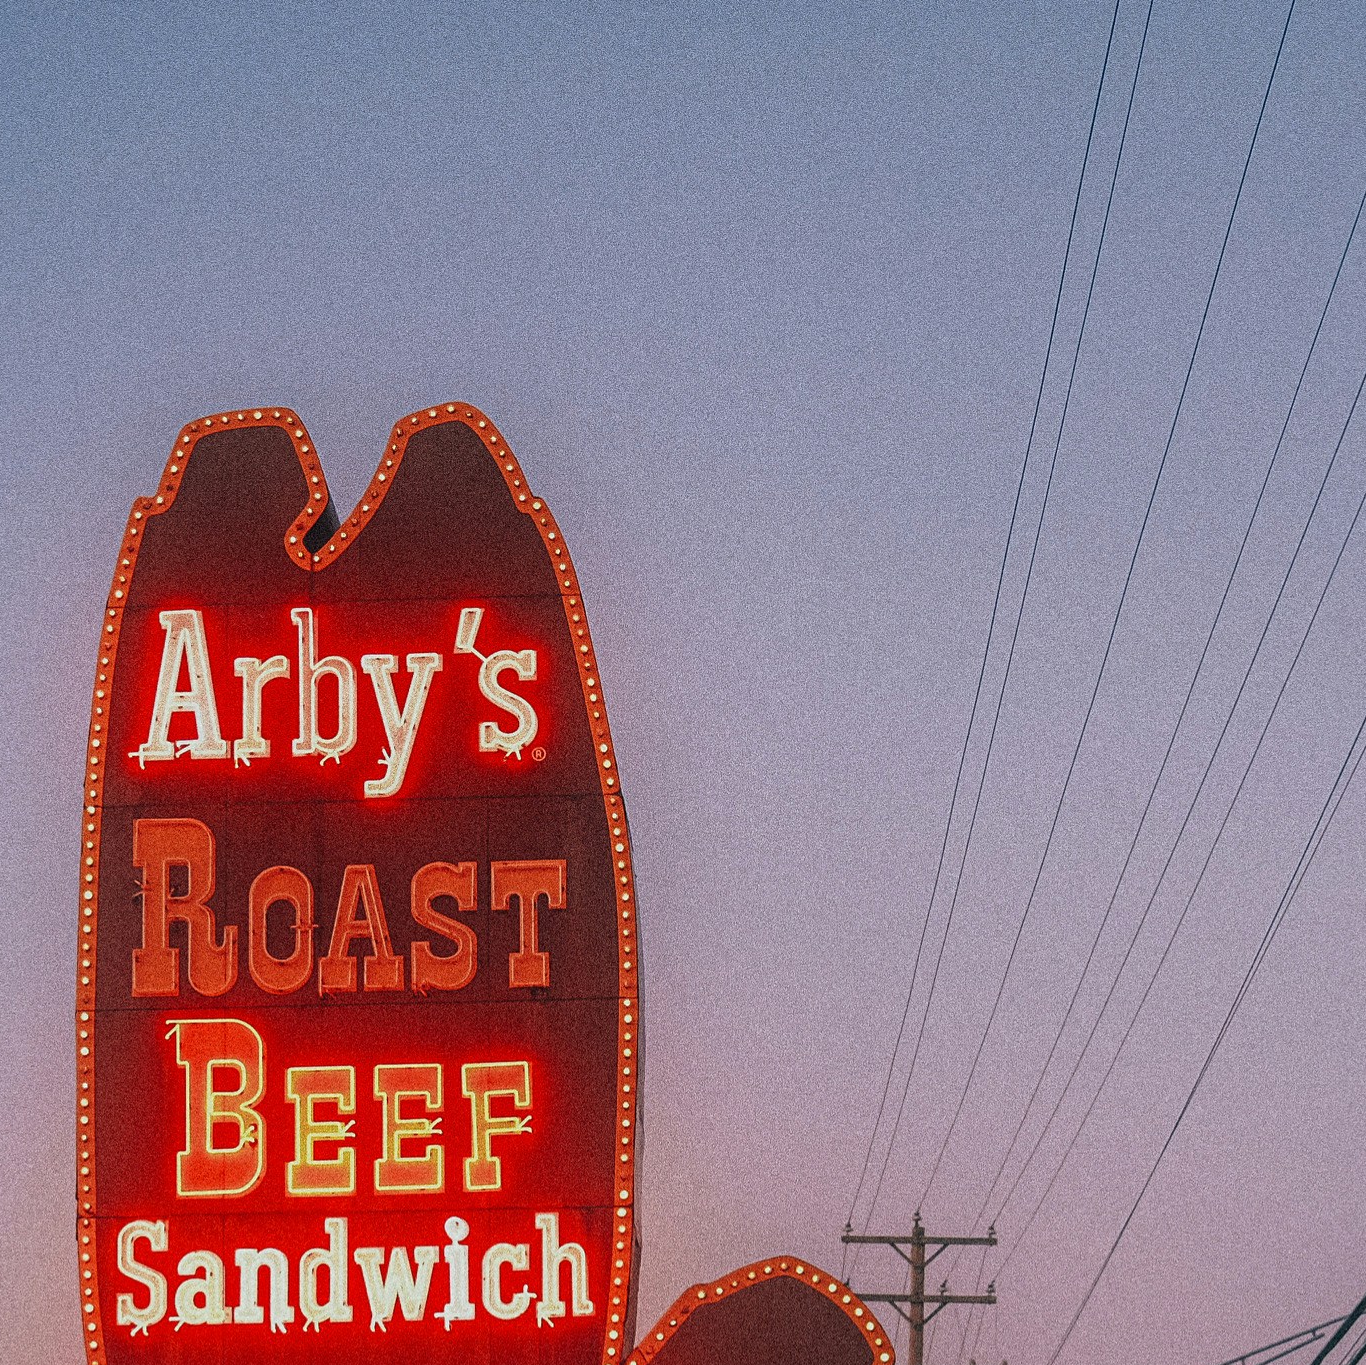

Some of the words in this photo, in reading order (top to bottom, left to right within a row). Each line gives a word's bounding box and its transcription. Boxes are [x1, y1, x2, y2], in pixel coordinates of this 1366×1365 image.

[137, 606, 537, 798] Arby's
[131, 817, 567, 998] ROAST
[171, 1017, 533, 1199] BEEF
[116, 1212, 594, 1328] Sandwich
